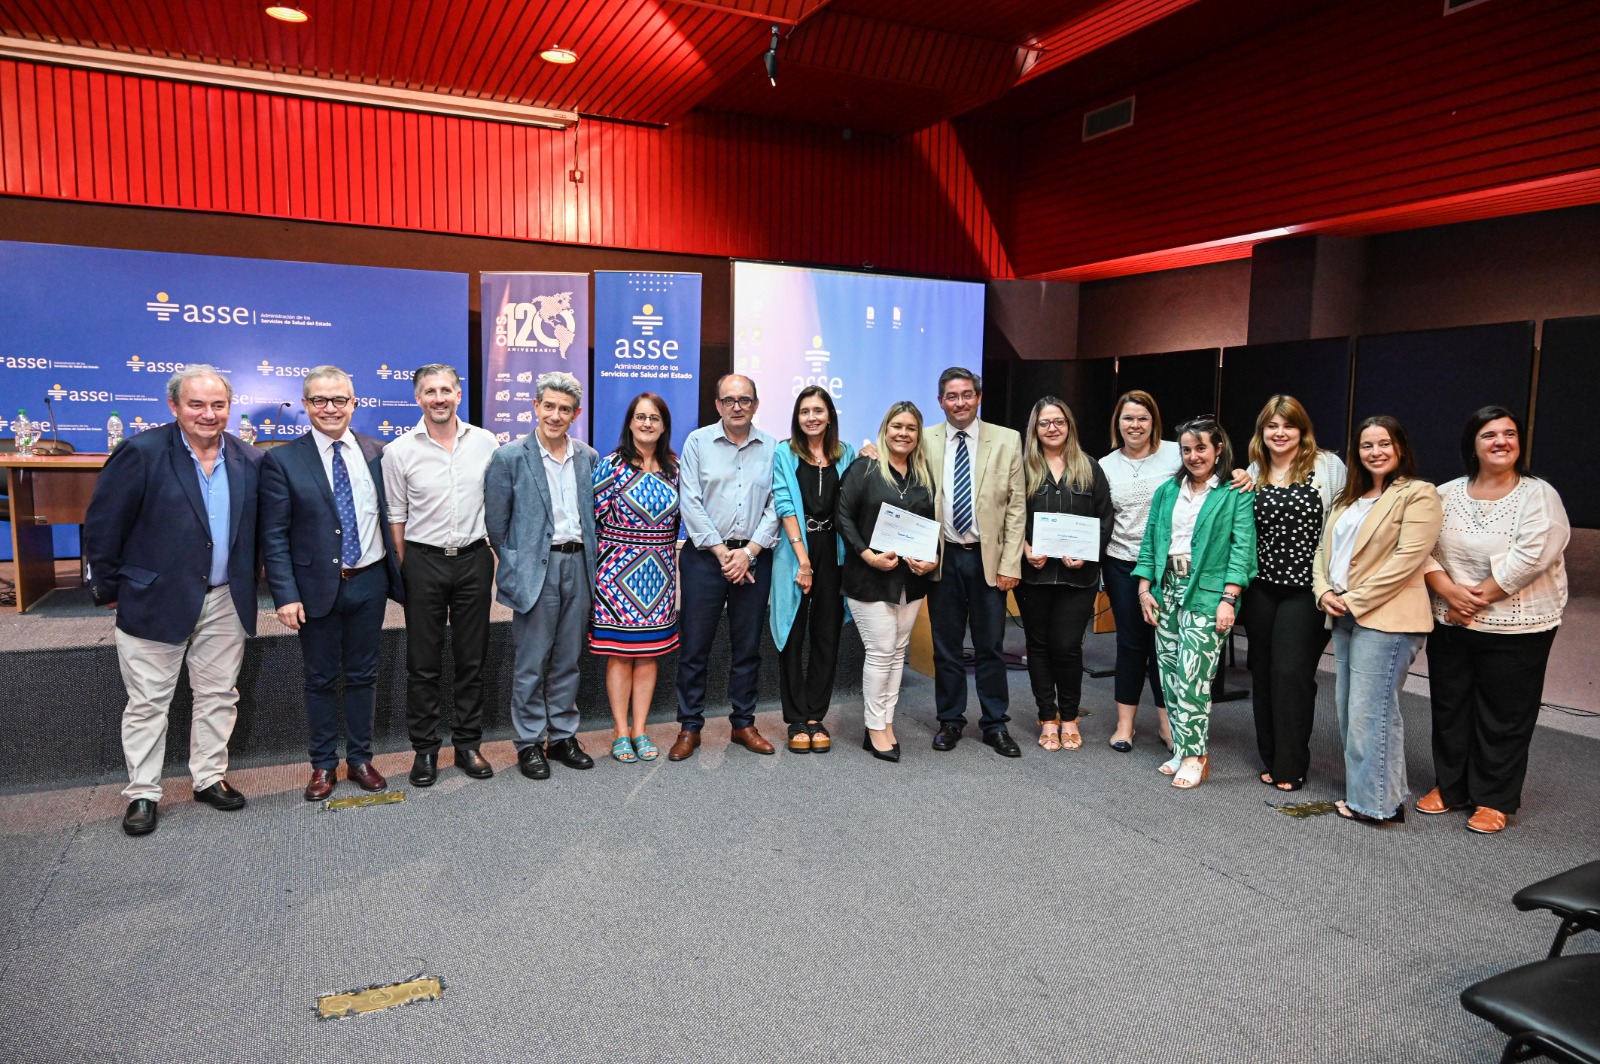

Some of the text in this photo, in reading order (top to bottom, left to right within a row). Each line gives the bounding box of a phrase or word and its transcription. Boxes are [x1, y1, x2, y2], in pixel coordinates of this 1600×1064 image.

[183, 304, 249, 325] asse
[496, 316, 508, 347] OPS
[614, 338, 679, 360] asse
[6, 357, 47, 369] asse
[147, 361, 184, 373] asse
[614, 363, 659, 371] Administración
[275, 366, 310, 377] asse
[394, 370, 416, 380] ass
[600, 370, 629, 378] Servicios
[69, 390, 109, 402] asse
